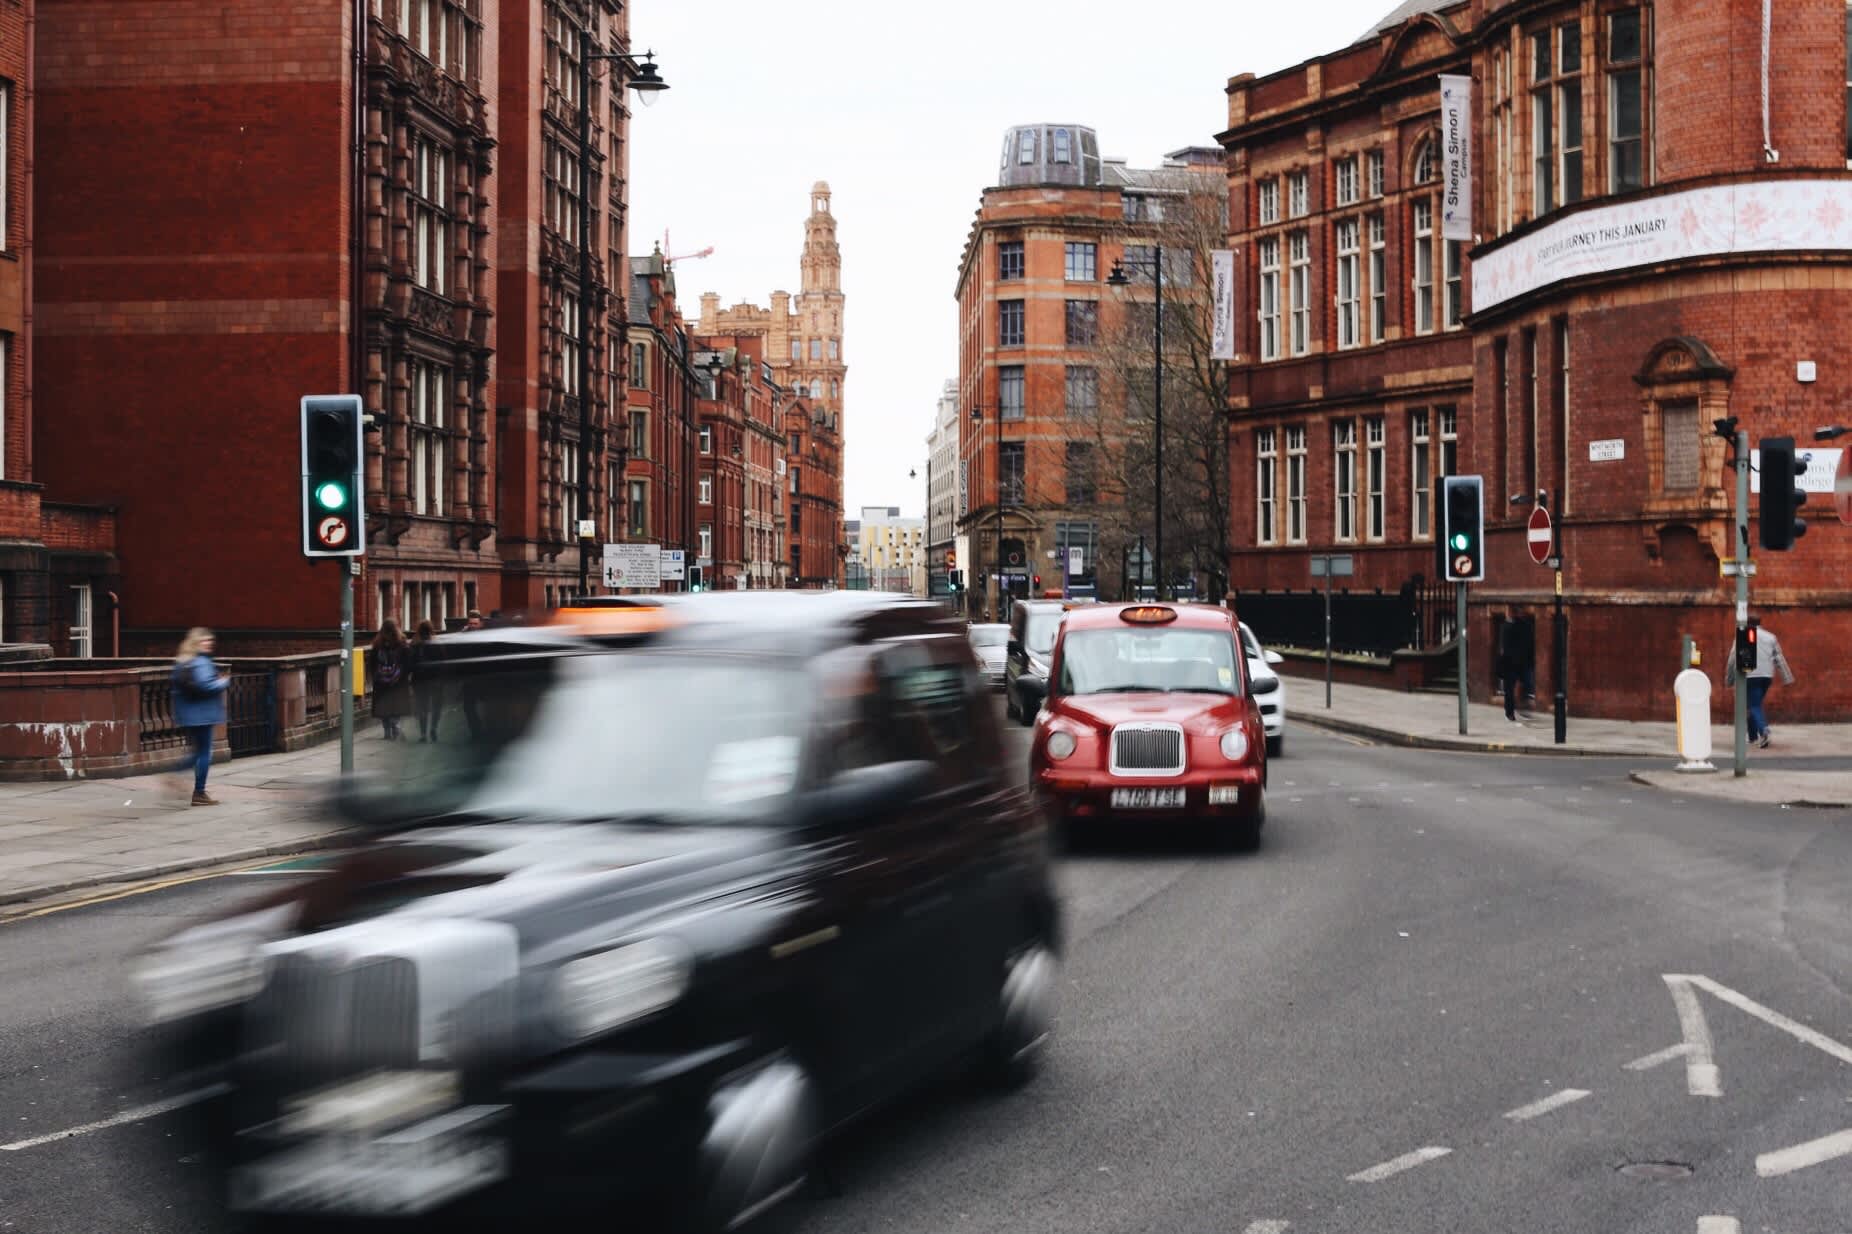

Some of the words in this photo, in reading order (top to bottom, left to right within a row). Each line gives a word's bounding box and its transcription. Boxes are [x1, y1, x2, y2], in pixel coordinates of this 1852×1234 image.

[1449, 108, 1459, 155] Simon
[1448, 160, 1459, 207] Shena
[1600, 225, 1626, 243] THIS
[1622, 218, 1668, 239] JANUARY
[1796, 474, 1832, 489] ollege
